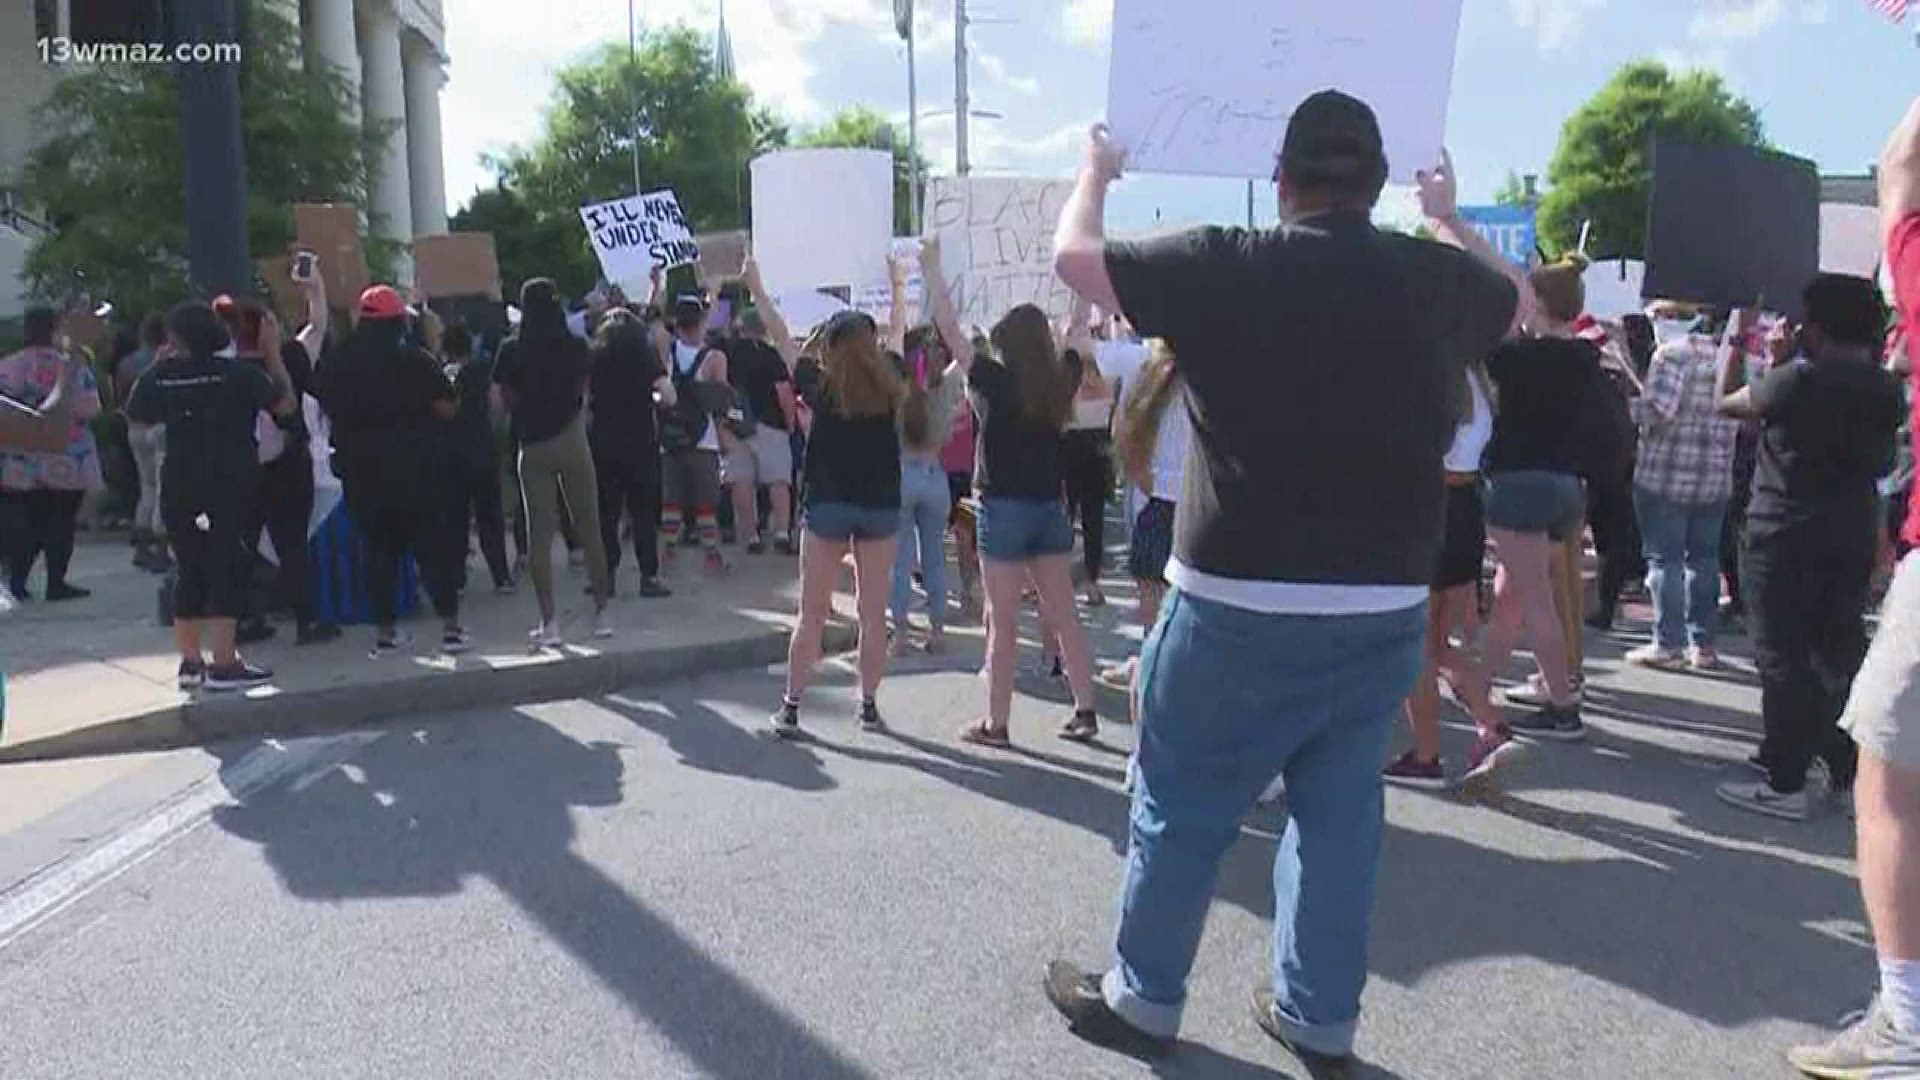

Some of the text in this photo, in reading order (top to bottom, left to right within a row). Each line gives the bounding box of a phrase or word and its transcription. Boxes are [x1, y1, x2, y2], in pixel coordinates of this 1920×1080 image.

[586, 203, 639, 231] I'LL
[933, 177, 1062, 228] BLAC
[598, 220, 662, 250] UNDER
